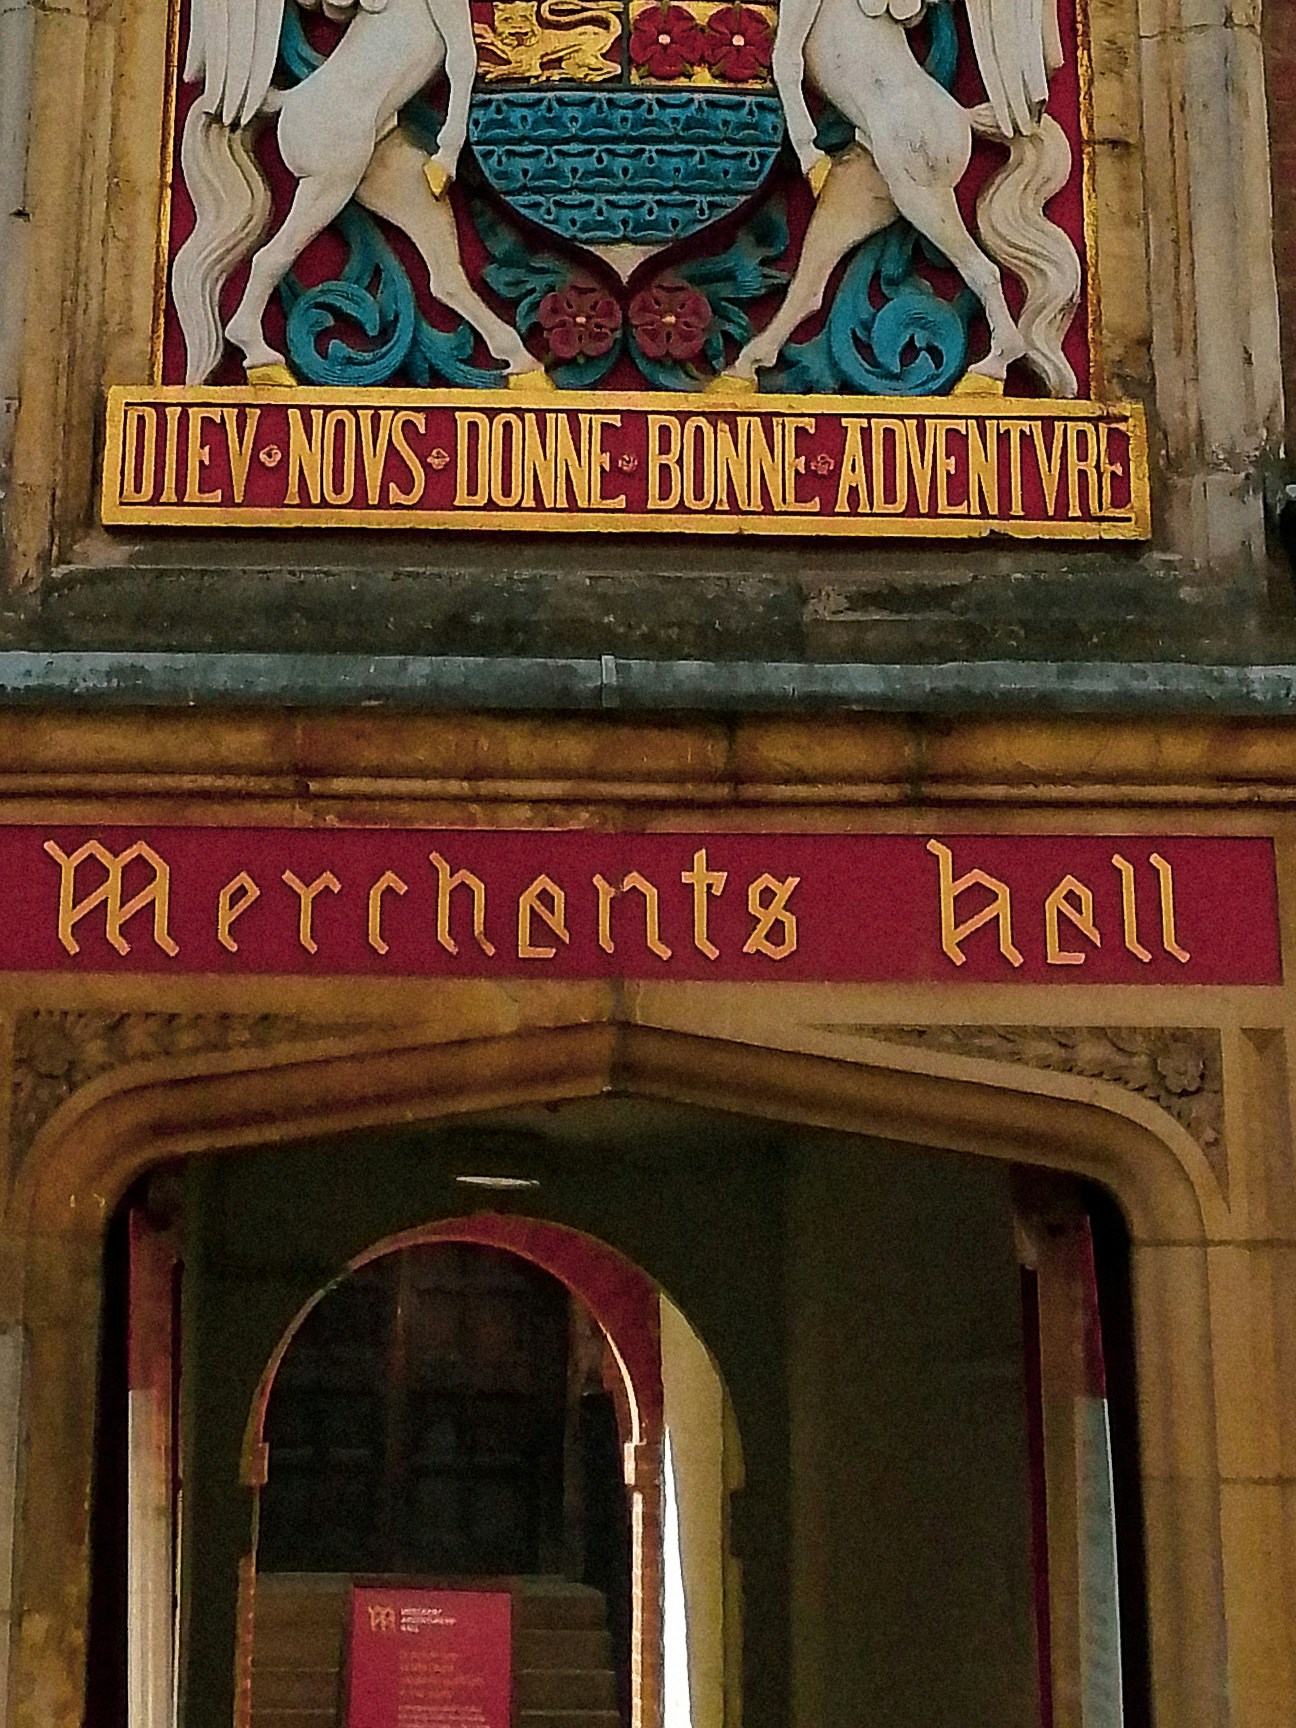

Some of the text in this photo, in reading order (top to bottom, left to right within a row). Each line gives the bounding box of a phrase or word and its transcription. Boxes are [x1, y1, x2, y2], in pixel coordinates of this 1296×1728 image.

[120, 405, 1135, 517] DIEV NOVS DONNE BONNE ADVENTVRE
[44, 837, 800, 959] Merchants
